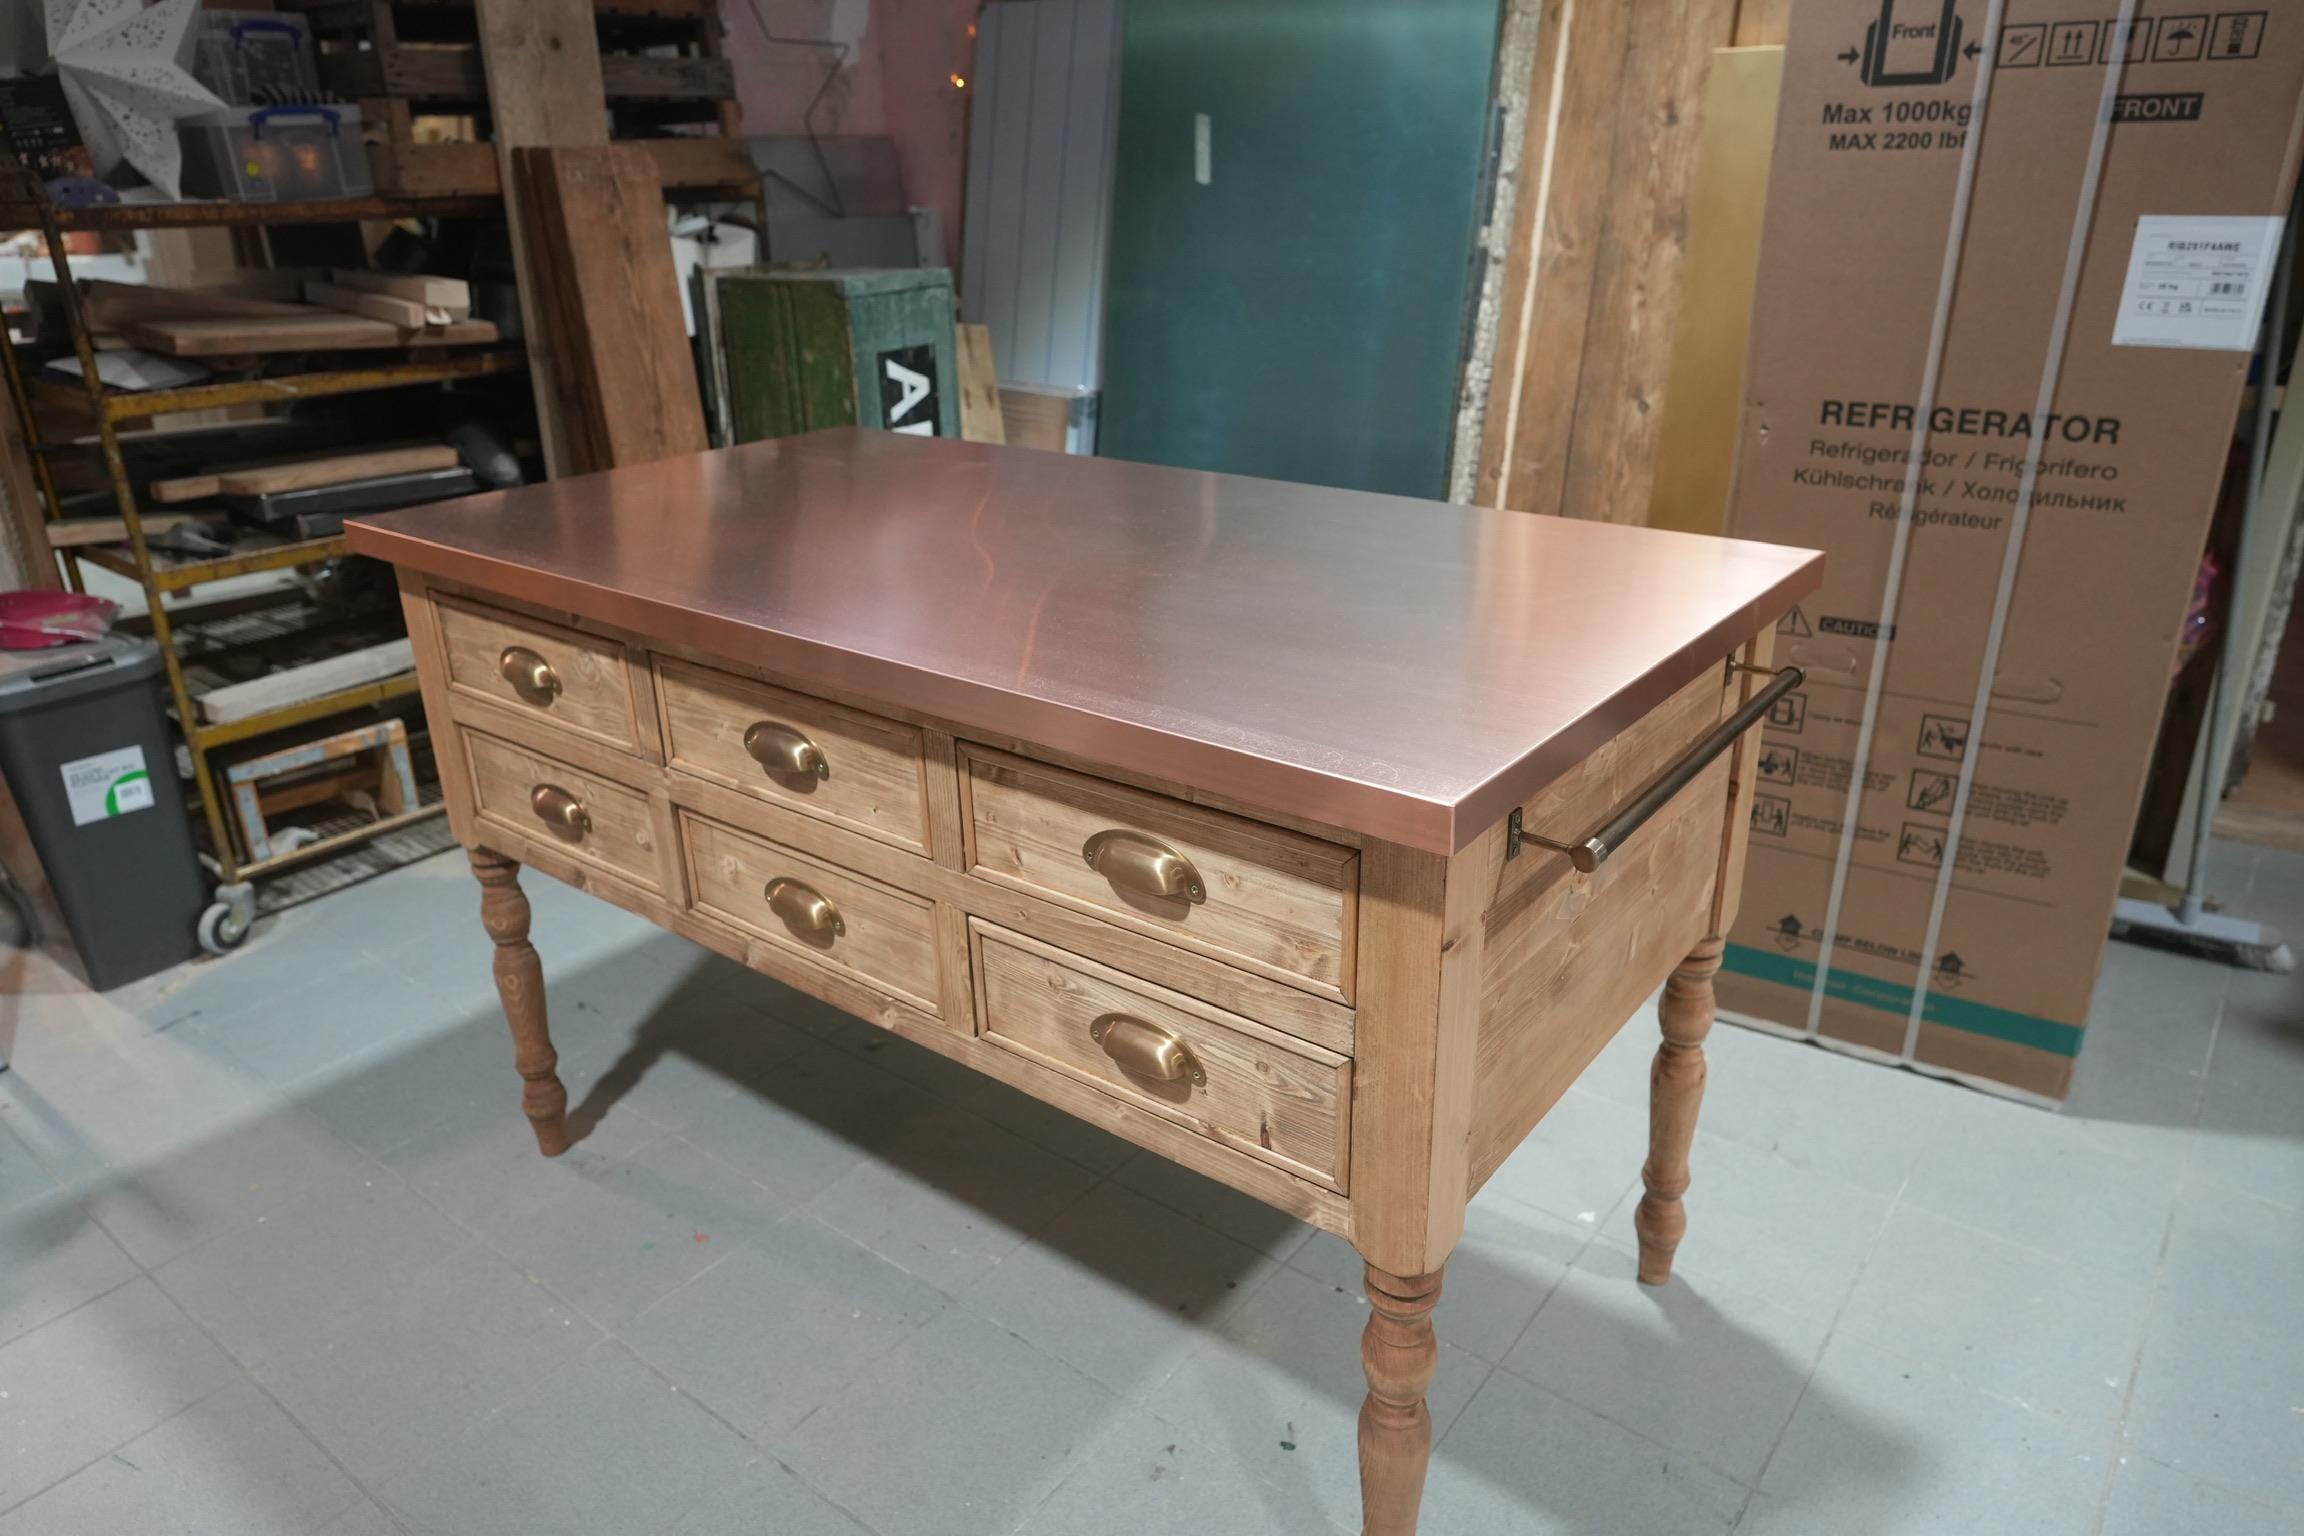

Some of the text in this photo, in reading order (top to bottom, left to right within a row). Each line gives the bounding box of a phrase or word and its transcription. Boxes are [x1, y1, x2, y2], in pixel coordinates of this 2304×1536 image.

[1892, 23, 1936, 39] Front
[1822, 100, 1973, 127] Max 1000kg
[1829, 133, 1877, 150] MAX
[1883, 131, 1932, 149] 2200
[1820, 400, 2122, 445] REFRGERATOR
[1964, 451, 1977, 470] /
[1943, 480, 1956, 497] /
[1869, 501, 2003, 530] Réigérateur
